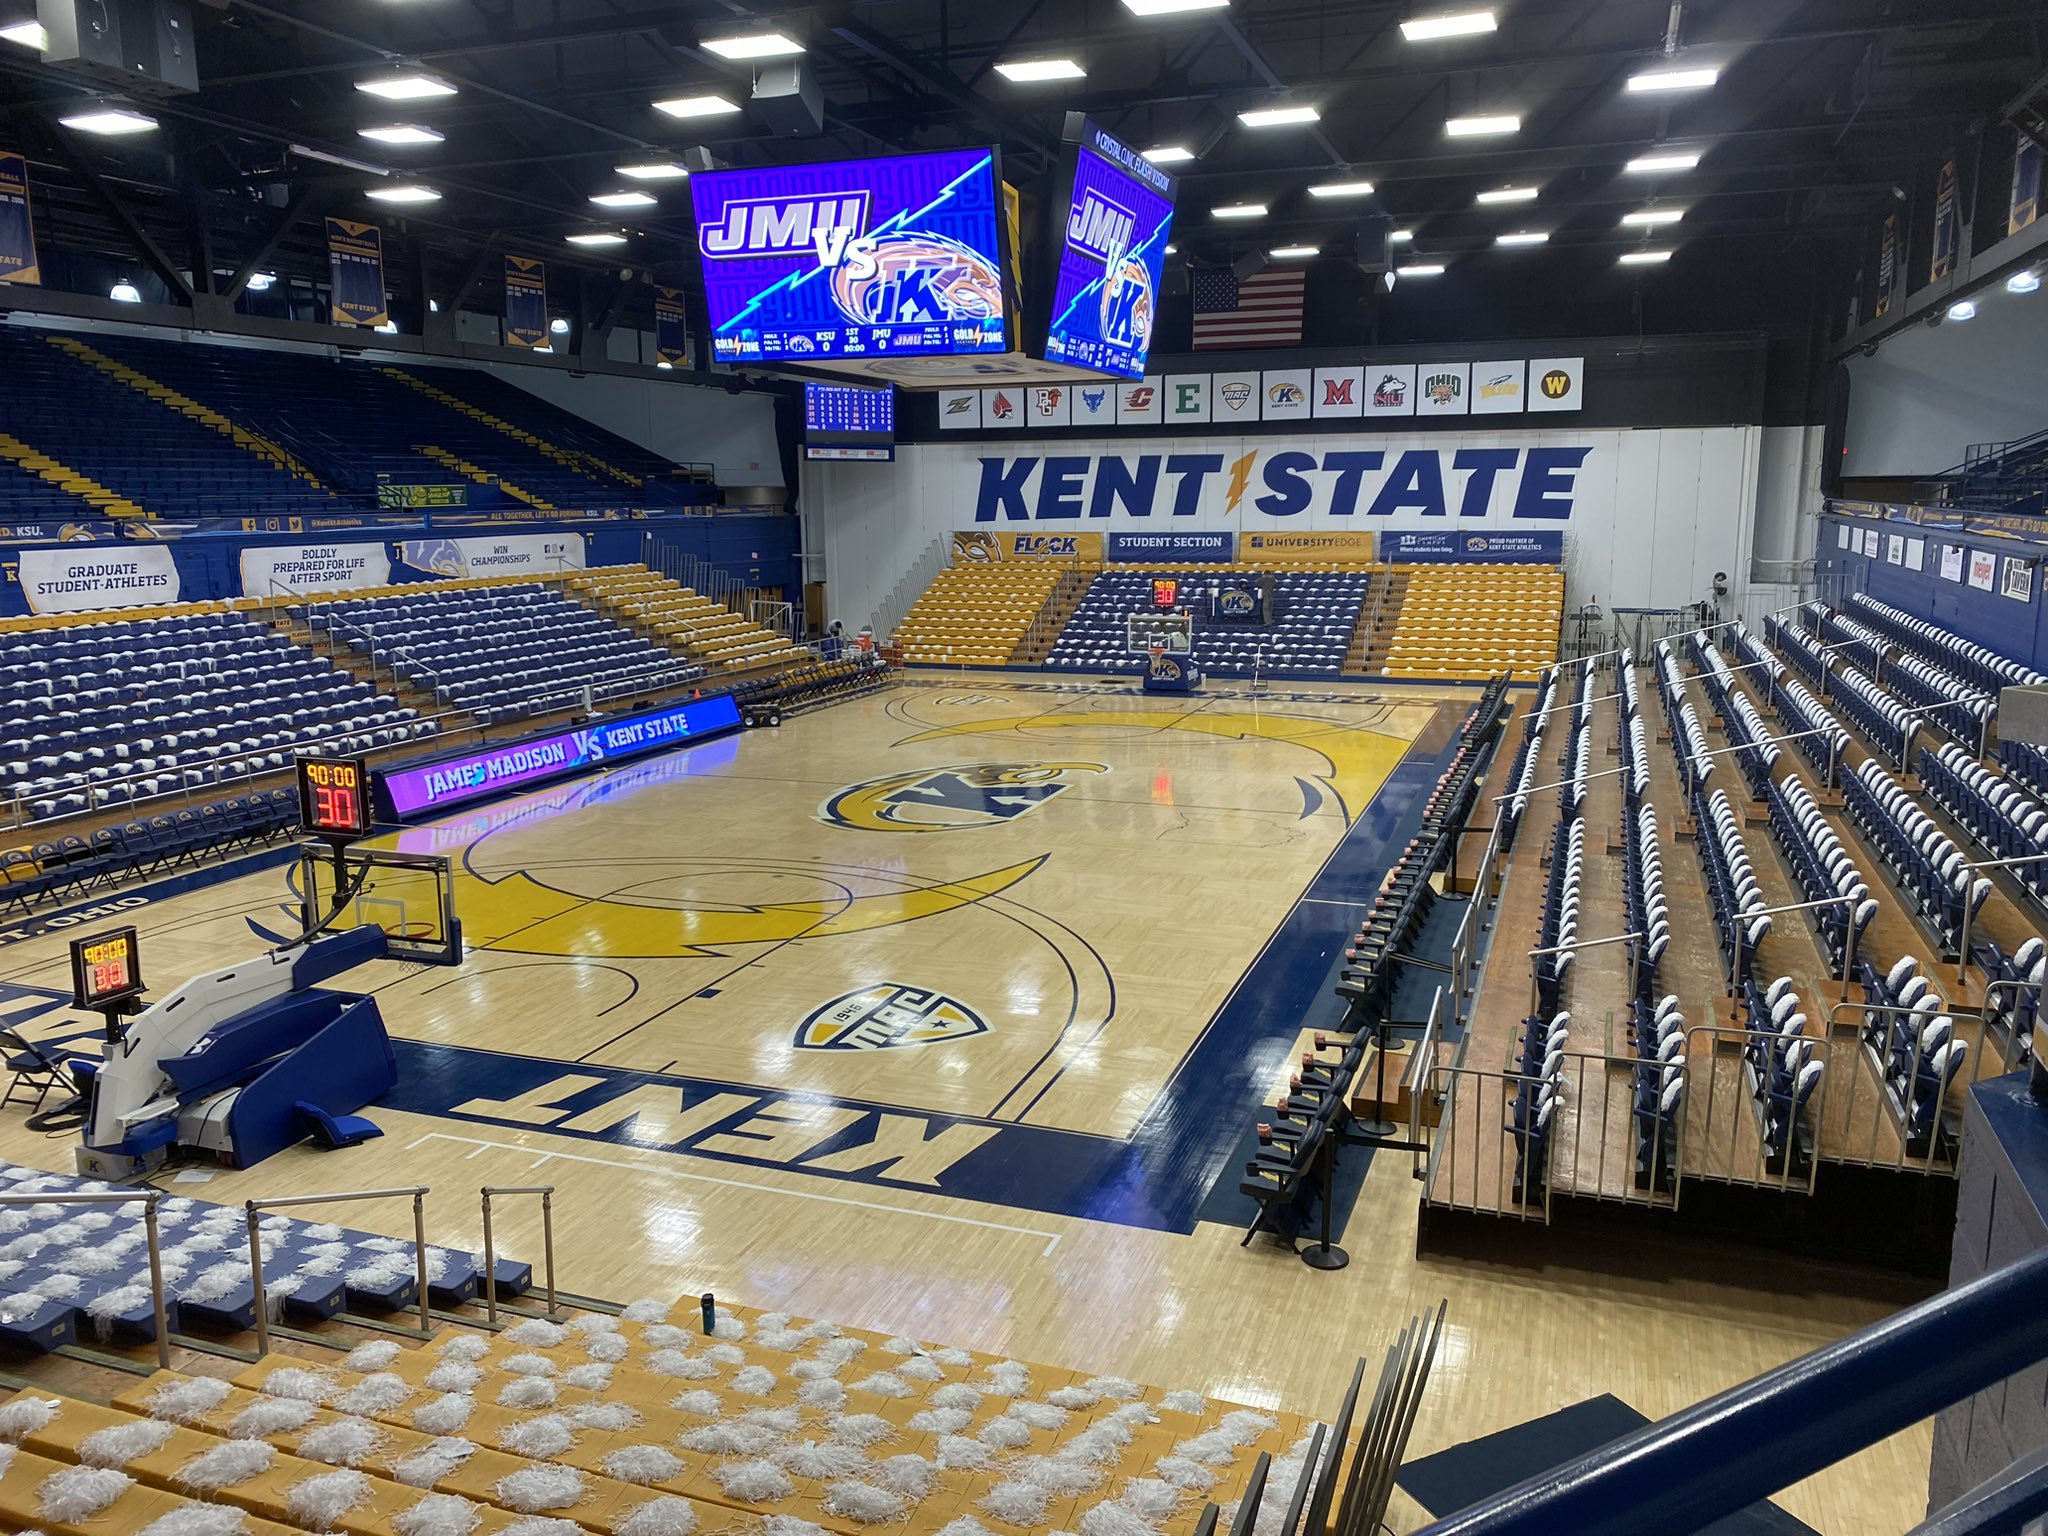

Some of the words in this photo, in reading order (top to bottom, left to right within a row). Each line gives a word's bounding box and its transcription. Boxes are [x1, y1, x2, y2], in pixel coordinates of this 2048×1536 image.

[811, 225, 878, 280] VS
[816, 331, 836, 341] KSU
[845, 328, 859, 336] 1ST
[872, 328, 892, 340] JMU
[954, 328, 974, 340] GOLD
[984, 332, 1003, 344] ZONE
[715, 338, 734, 350] GOLD
[742, 341, 760, 352] ZONE
[822, 342, 830, 352] 0
[844, 344, 866, 352] 90:00
[878, 340, 886, 350] 0
[1322, 378, 1355, 406] M
[1546, 376, 1567, 394] W
[1175, 384, 1200, 414] E
[1224, 390, 1250, 400] MAC
[1278, 388, 1294, 403] K
[1373, 392, 1404, 406] NIU
[975, 453, 1224, 522] KENT
[1254, 446, 1593, 520] STATE
[16, 526, 44, 536] KSU.
[1014, 537, 1079, 552] FLOCK
[1118, 536, 1172, 548] STUDENT
[1173, 536, 1222, 548] SECTION
[1266, 536, 1362, 548] UNIVERSITYEDGE
[302, 548, 337, 560] BOLDLY
[493, 546, 508, 555] WIN
[273, 560, 325, 573] PREPARED
[326, 559, 345, 570] FOR
[346, 558, 365, 568] LIFE
[470, 554, 531, 567] CHAMPIONSHIPS
[6, 570, 17, 582] K
[68, 563, 138, 578] GRADUATE
[289, 572, 321, 584] AFTER
[322, 570, 353, 582] SPORT
[37, 574, 168, 595] STUDENT-ATHLETES
[1154, 580, 1176, 590] 90:00
[1157, 589, 1172, 603] 30
[424, 763, 485, 800] JAMES
[486, 743, 566, 779] MADISON
[571, 729, 604, 761] VS
[606, 724, 644, 749] KENT
[645, 713, 688, 739] STATE
[306, 764, 356, 788] 90:00
[316, 787, 353, 825] 30
[45, 896, 150, 928] OHIO
[84, 938, 128, 964] 90:00
[95, 961, 122, 991] 30
[447, 1074, 1003, 1188] KENT
